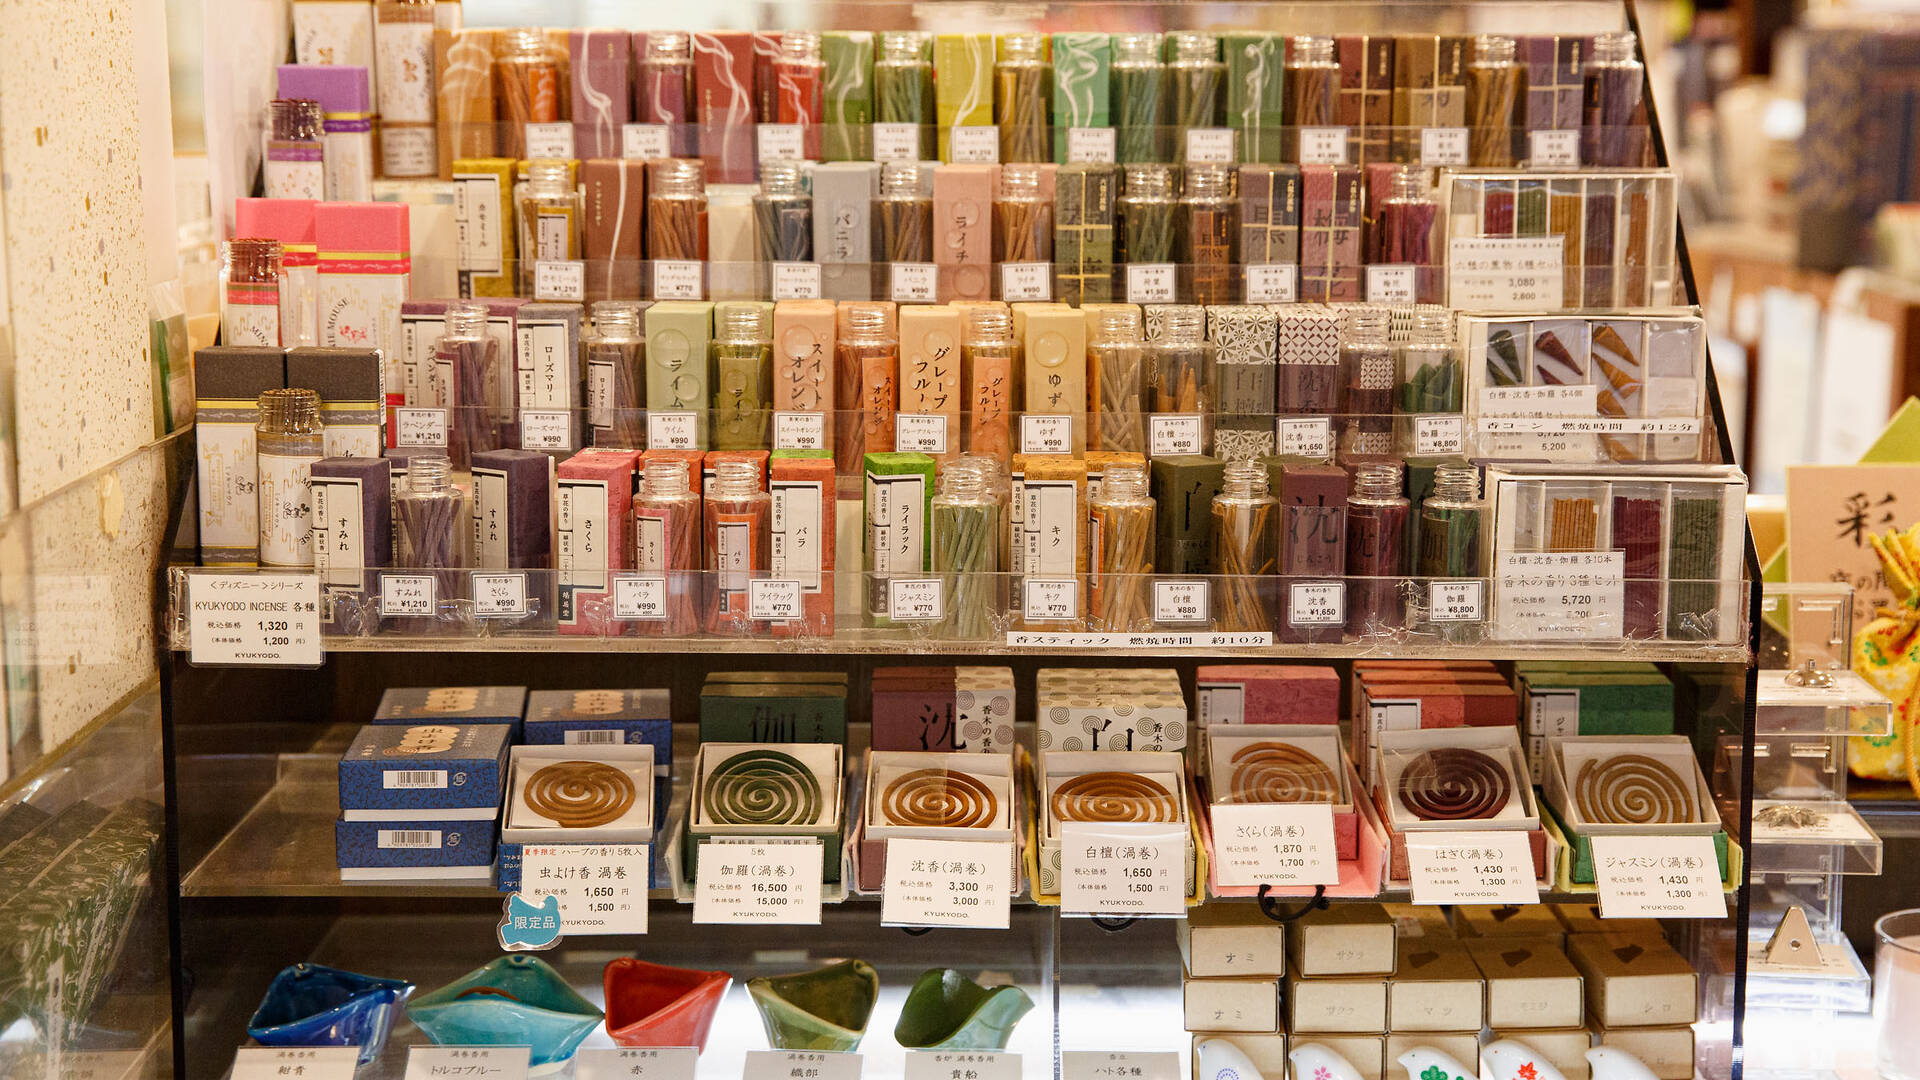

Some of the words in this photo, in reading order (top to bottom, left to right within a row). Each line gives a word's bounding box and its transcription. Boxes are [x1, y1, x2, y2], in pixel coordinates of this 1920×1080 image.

[834, 213, 851, 259] バニラ
[954, 216, 969, 262] ライチ
[544, 346, 554, 401] ローズマリー
[811, 343, 823, 404] スイート
[934, 346, 950, 410] グレープ
[669, 359, 685, 409] ライム
[1048, 374, 1062, 408] ゆず
[1172, 440, 1190, 448] ¥880
[1433, 440, 1458, 448] ¥8,800
[1542, 442, 1566, 451] 5,200
[489, 507, 498, 542] すみれ
[901, 504, 910, 555] ライラック
[338, 518, 350, 551] すみれ
[796, 526, 808, 548] バラ
[1052, 526, 1060, 548] キク
[1584, 555, 1612, 564] 各10本
[394, 589, 422, 597] すみれ
[491, 588, 508, 597] さくら
[760, 592, 792, 600] ライラック
[900, 593, 936, 602] ジャスミン
[401, 600, 428, 608] ¥1,210
[1172, 595, 1192, 604] 白檀
[1308, 597, 1327, 606] 沈香
[1562, 595, 1591, 606] 5,720
[195, 601, 246, 612] KYUKYODO
[250, 601, 288, 612] INCENSE
[293, 601, 316, 613] 各種
[637, 602, 656, 610] ¥990
[772, 604, 792, 612] ¥770
[914, 604, 933, 612] ¥770
[1048, 604, 1067, 612] ¥770
[1178, 606, 1196, 614] ¥880
[1448, 605, 1474, 614] ¥8,800
[1310, 608, 1336, 616] ¥1,650
[258, 621, 288, 632] 1,320
[263, 637, 289, 646] 1,200
[1016, 636, 1110, 644] 香スティック
[1129, 636, 1192, 645] 燃焼時間
[1211, 636, 1266, 645] 約10分
[1236, 825, 1304, 838] さくら(渦巻)
[524, 848, 556, 856] 夏季限定
[751, 848, 766, 856] 5枚
[1086, 846, 1160, 860] 白檀(渦巻)
[1273, 844, 1302, 854] 1,870
[1436, 848, 1504, 860] はぎ(渦巻)
[911, 860, 986, 875] 沈香(渦巻)
[1280, 859, 1304, 867] 1,700
[1606, 856, 1704, 870] ジャスミン(渦巻)
[540, 866, 591, 880] 虫よけ香
[598, 866, 626, 880] 渦巻
[720, 864, 794, 877] 伽羅(渦巻)
[1074, 868, 1107, 876] 税込価格
[1122, 868, 1152, 878] 1,650
[1473, 865, 1503, 874] 1,430
[1480, 878, 1506, 886] 1,300
[1659, 875, 1689, 885] 1,430
[752, 883, 788, 892] 16,500
[900, 880, 932, 888] 税込価格
[949, 882, 978, 892] 3,300
[1128, 884, 1152, 893] 1,500
[534, 888, 568, 896] 税込価格
[584, 887, 614, 898] 1,650
[622, 888, 628, 896] 円
[1666, 890, 1692, 898] 1,300
[756, 898, 788, 906] 15,000
[952, 897, 978, 906] 3,000
[588, 904, 614, 912] 1,500
[514, 916, 556, 929] 限定品
[430, 1065, 502, 1076] トルコブルー
[630, 1064, 644, 1076] 赤
[790, 1068, 819, 1078] 織部
[952, 1069, 978, 1080] 貴船
[1096, 1066, 1142, 1077] ハト各種
